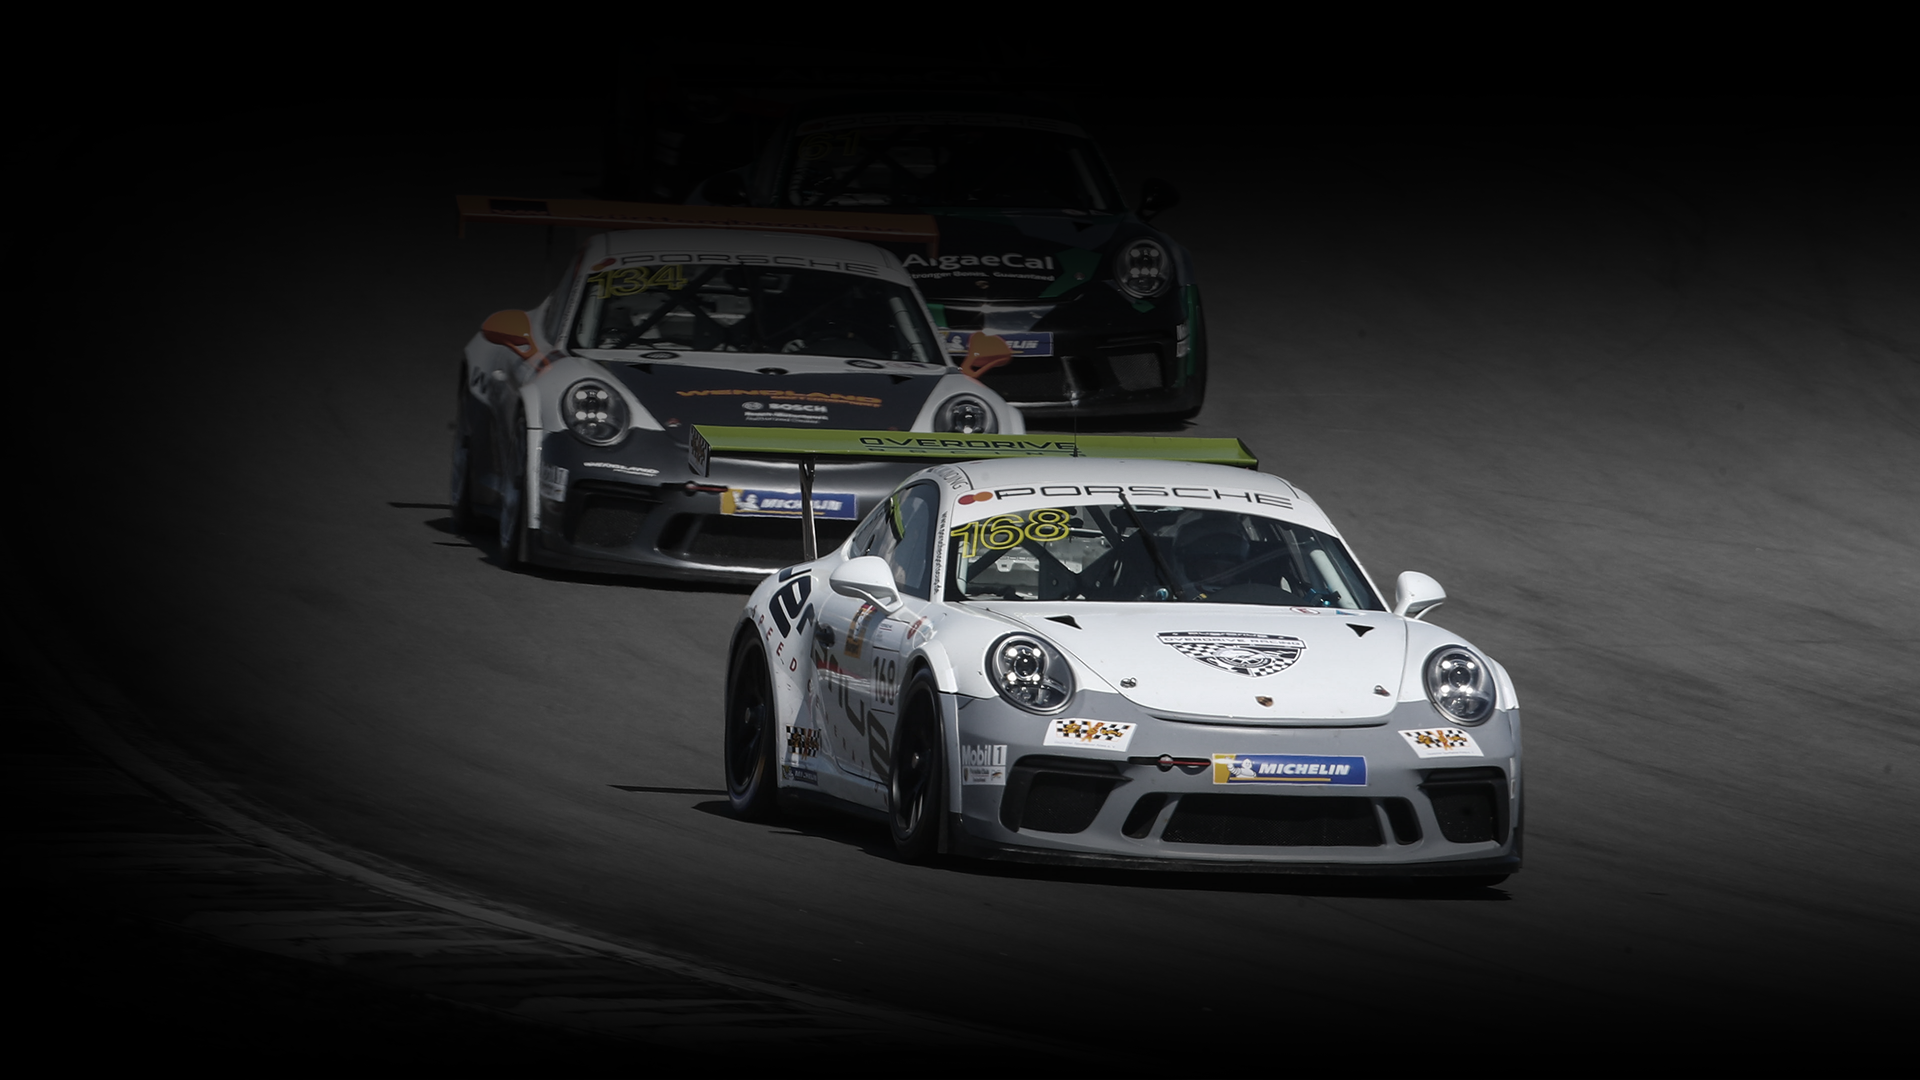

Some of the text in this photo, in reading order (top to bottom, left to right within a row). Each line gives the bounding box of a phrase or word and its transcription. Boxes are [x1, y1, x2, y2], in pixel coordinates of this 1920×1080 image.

[621, 253, 879, 275] PORSCHE
[588, 263, 689, 299] 134
[909, 271, 951, 280] tronger
[768, 403, 828, 413] BOSCH
[859, 437, 1078, 450] OVERDRIVE
[760, 498, 843, 511] MICHLIN
[994, 486, 1293, 509] PORSCHE
[950, 508, 1070, 559] 168
[962, 744, 991, 765] Mobil
[1258, 763, 1350, 775] MICHELIN
